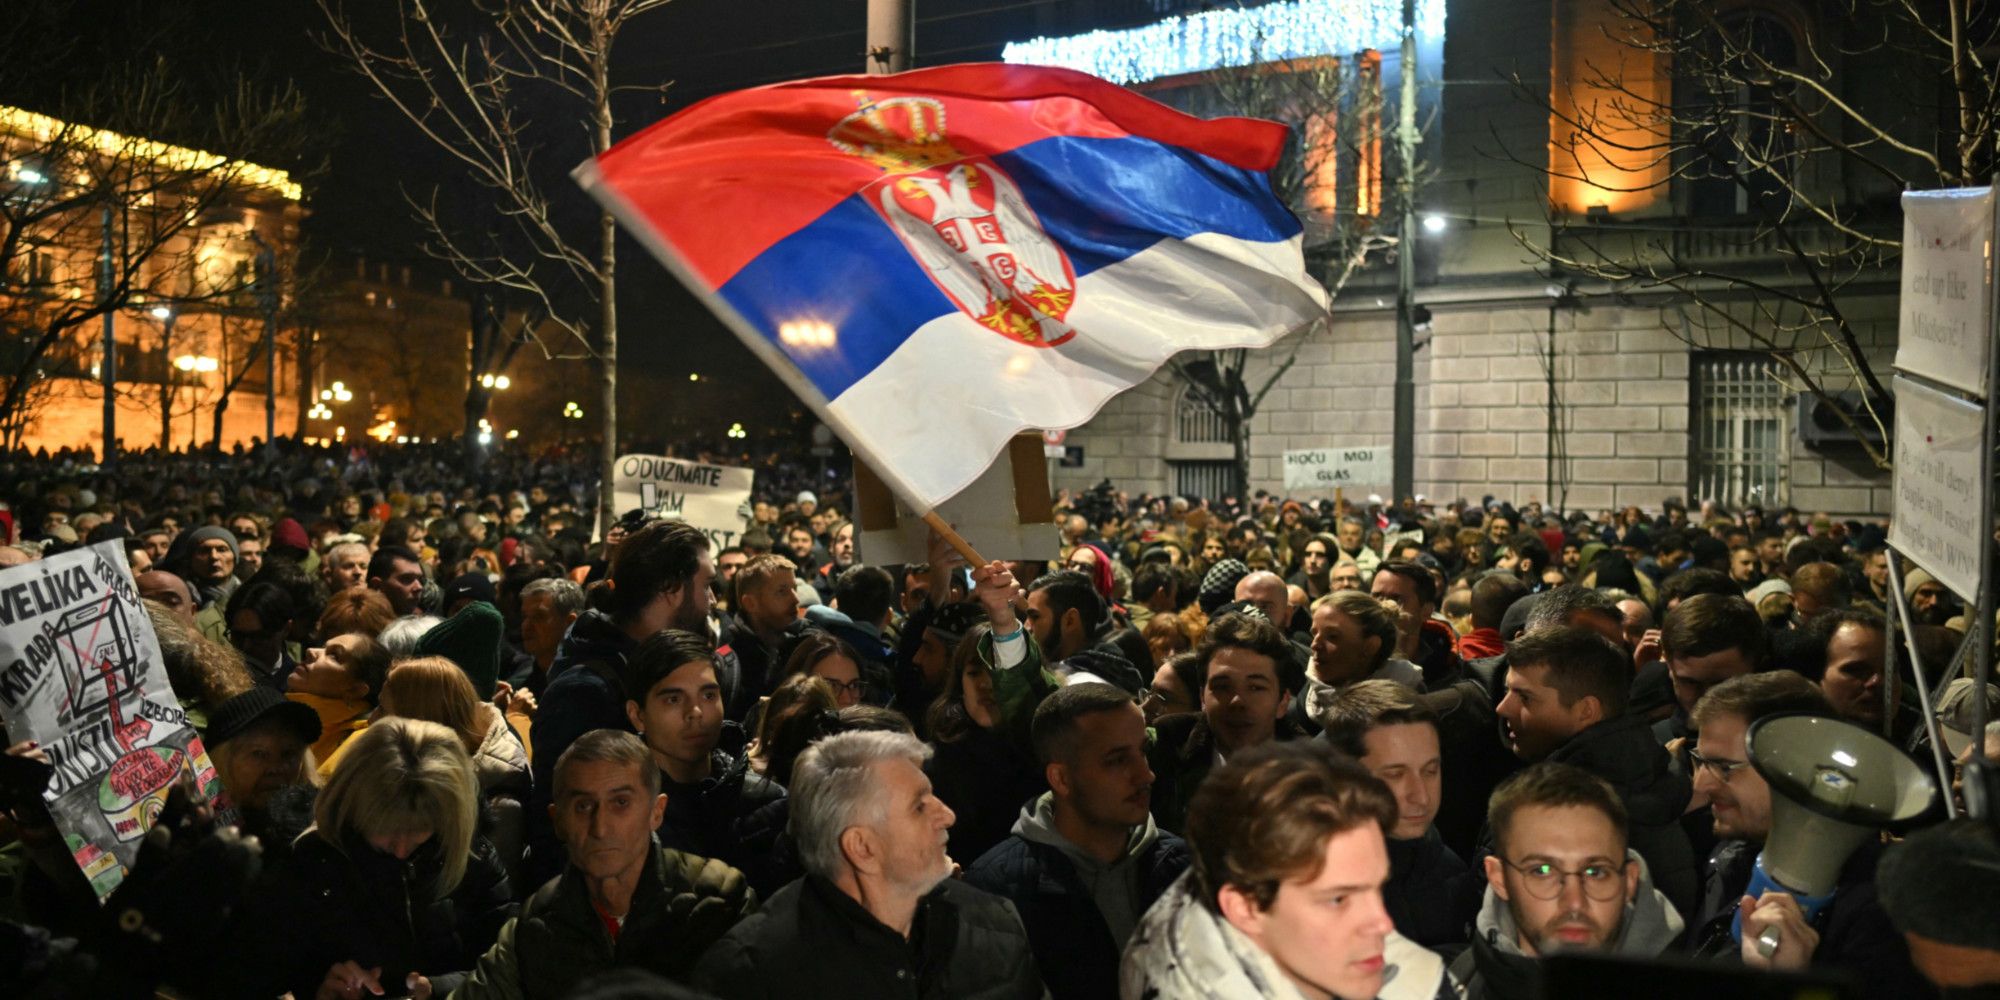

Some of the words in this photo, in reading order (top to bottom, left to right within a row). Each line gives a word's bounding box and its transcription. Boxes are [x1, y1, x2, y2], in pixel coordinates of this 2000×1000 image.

[1912, 269, 1929, 295] end
[1946, 270, 1967, 301] like
[1344, 450, 1373, 462] MOJ
[623, 457, 722, 487] ODUZIMATE
[1316, 468, 1350, 481] GLAS
